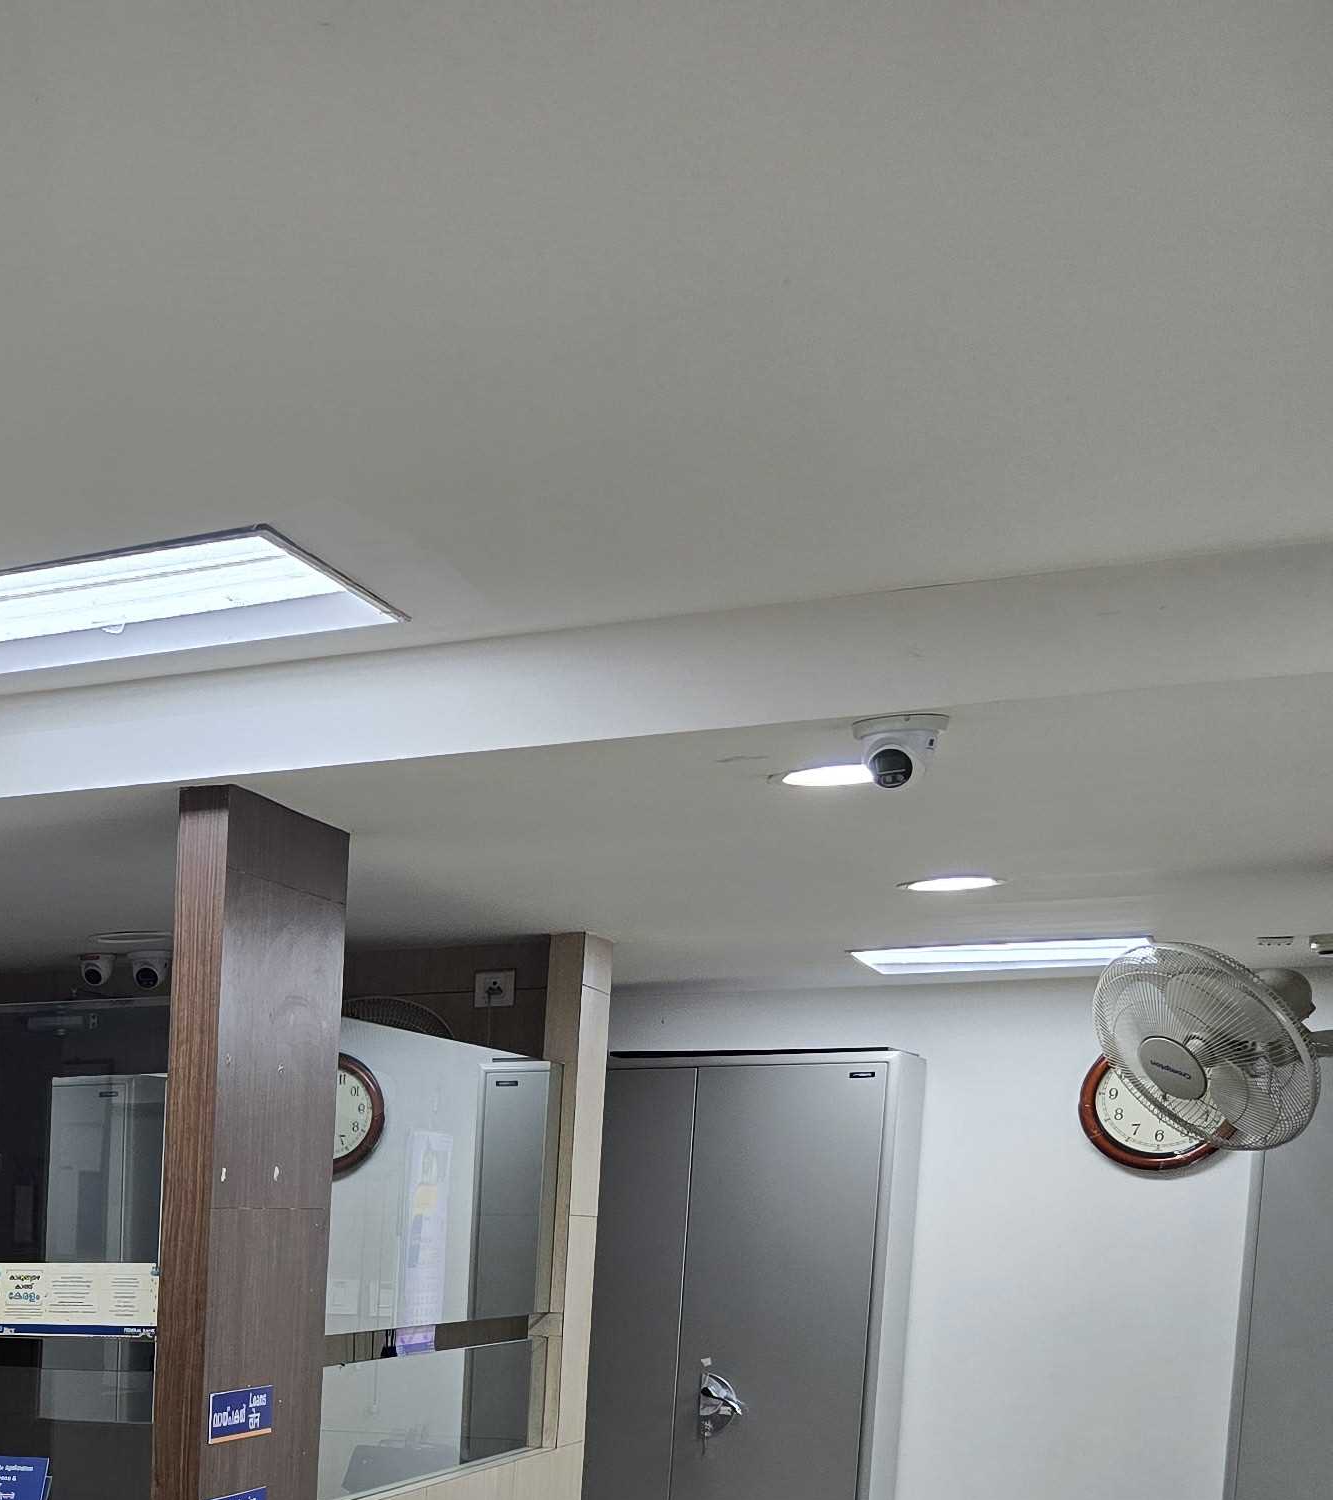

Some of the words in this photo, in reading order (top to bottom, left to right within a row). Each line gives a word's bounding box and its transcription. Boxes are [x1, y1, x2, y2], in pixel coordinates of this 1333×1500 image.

[1108, 1088, 1118, 1100] 9
[1114, 1107, 1124, 1121] 8
[1131, 1123, 1141, 1136] 7
[1154, 1130, 1165, 1142] 6
[8, 1291, 41, 1303] കേരളം
[248, 1392, 267, 1408] Loans
